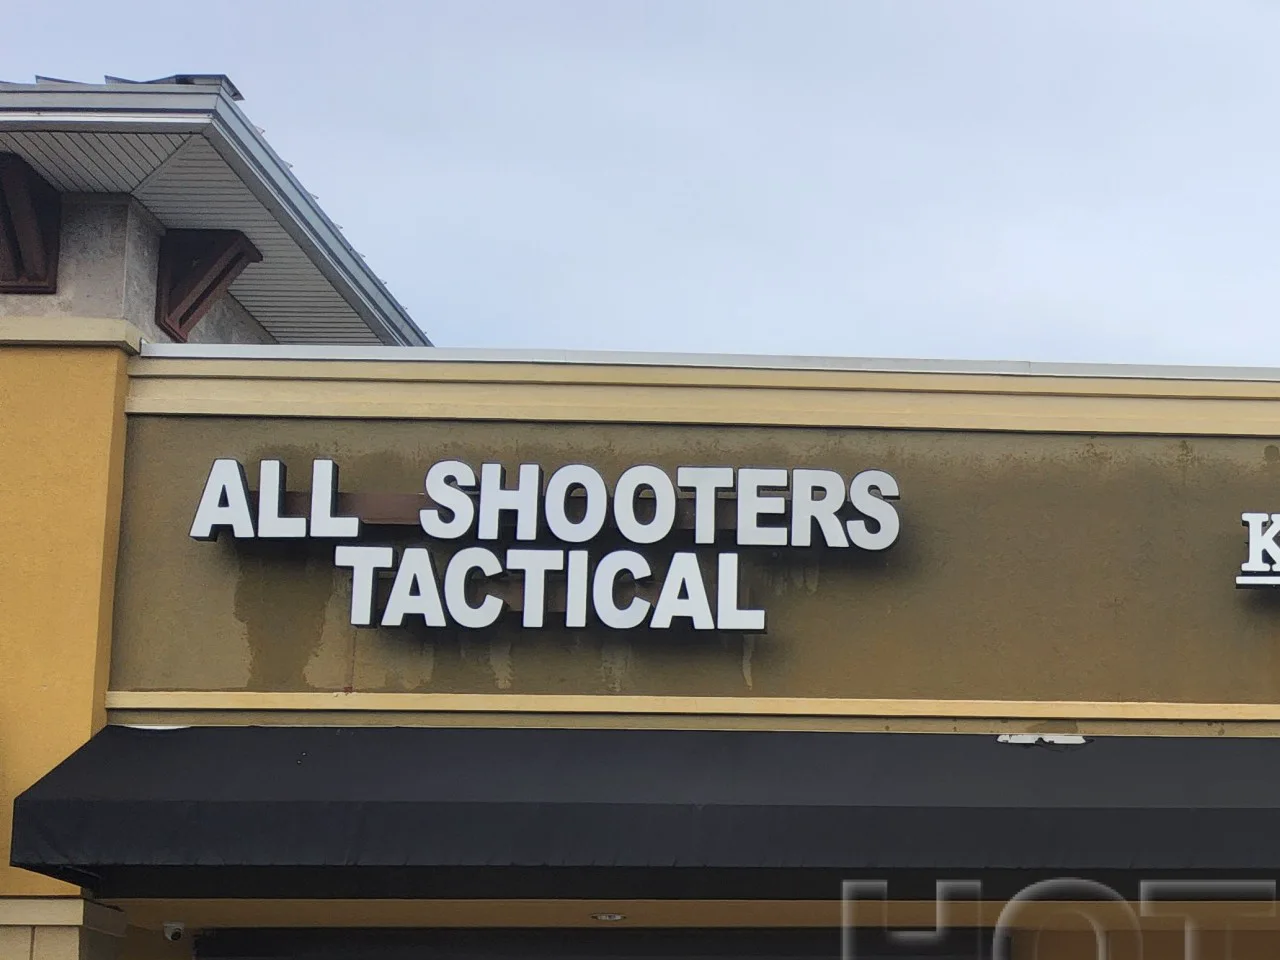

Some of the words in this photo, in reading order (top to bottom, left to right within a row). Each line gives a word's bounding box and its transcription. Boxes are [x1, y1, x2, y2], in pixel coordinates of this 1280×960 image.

[189, 459, 359, 541] ALL
[418, 458, 900, 551] SHOOTERS
[334, 545, 767, 631] TACTICAL
